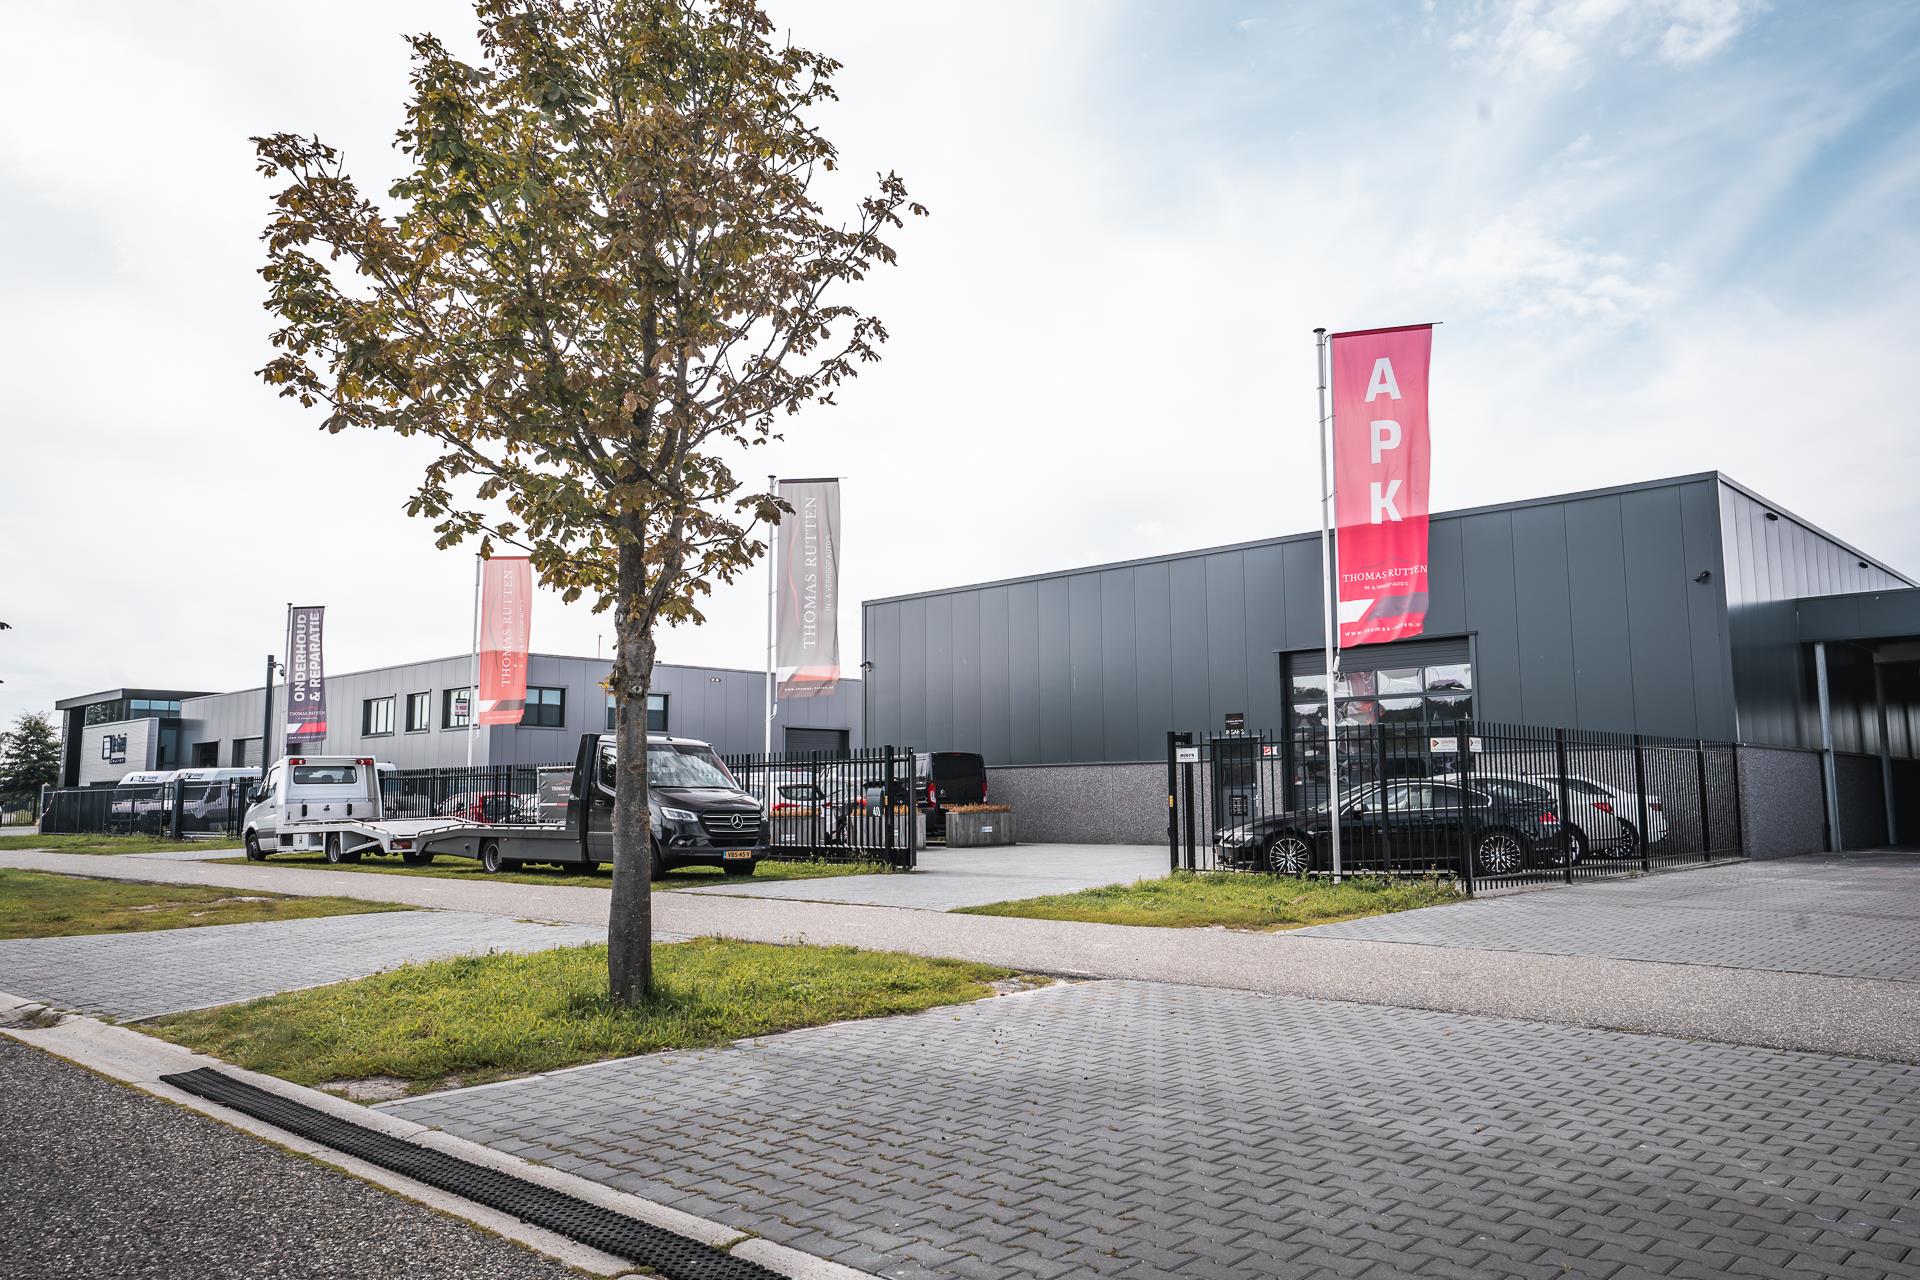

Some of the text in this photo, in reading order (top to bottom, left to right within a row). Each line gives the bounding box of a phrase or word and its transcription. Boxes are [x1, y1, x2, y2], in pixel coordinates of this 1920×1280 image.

[1365, 357, 1402, 525] APK
[804, 497, 817, 649] THOMAS RUTTEN
[1342, 571, 1387, 583] THOMAS
[294, 614, 307, 702] ONDERHOUD
[309, 612, 321, 701] & REPARATIE
[501, 629, 513, 688] THOMAS
